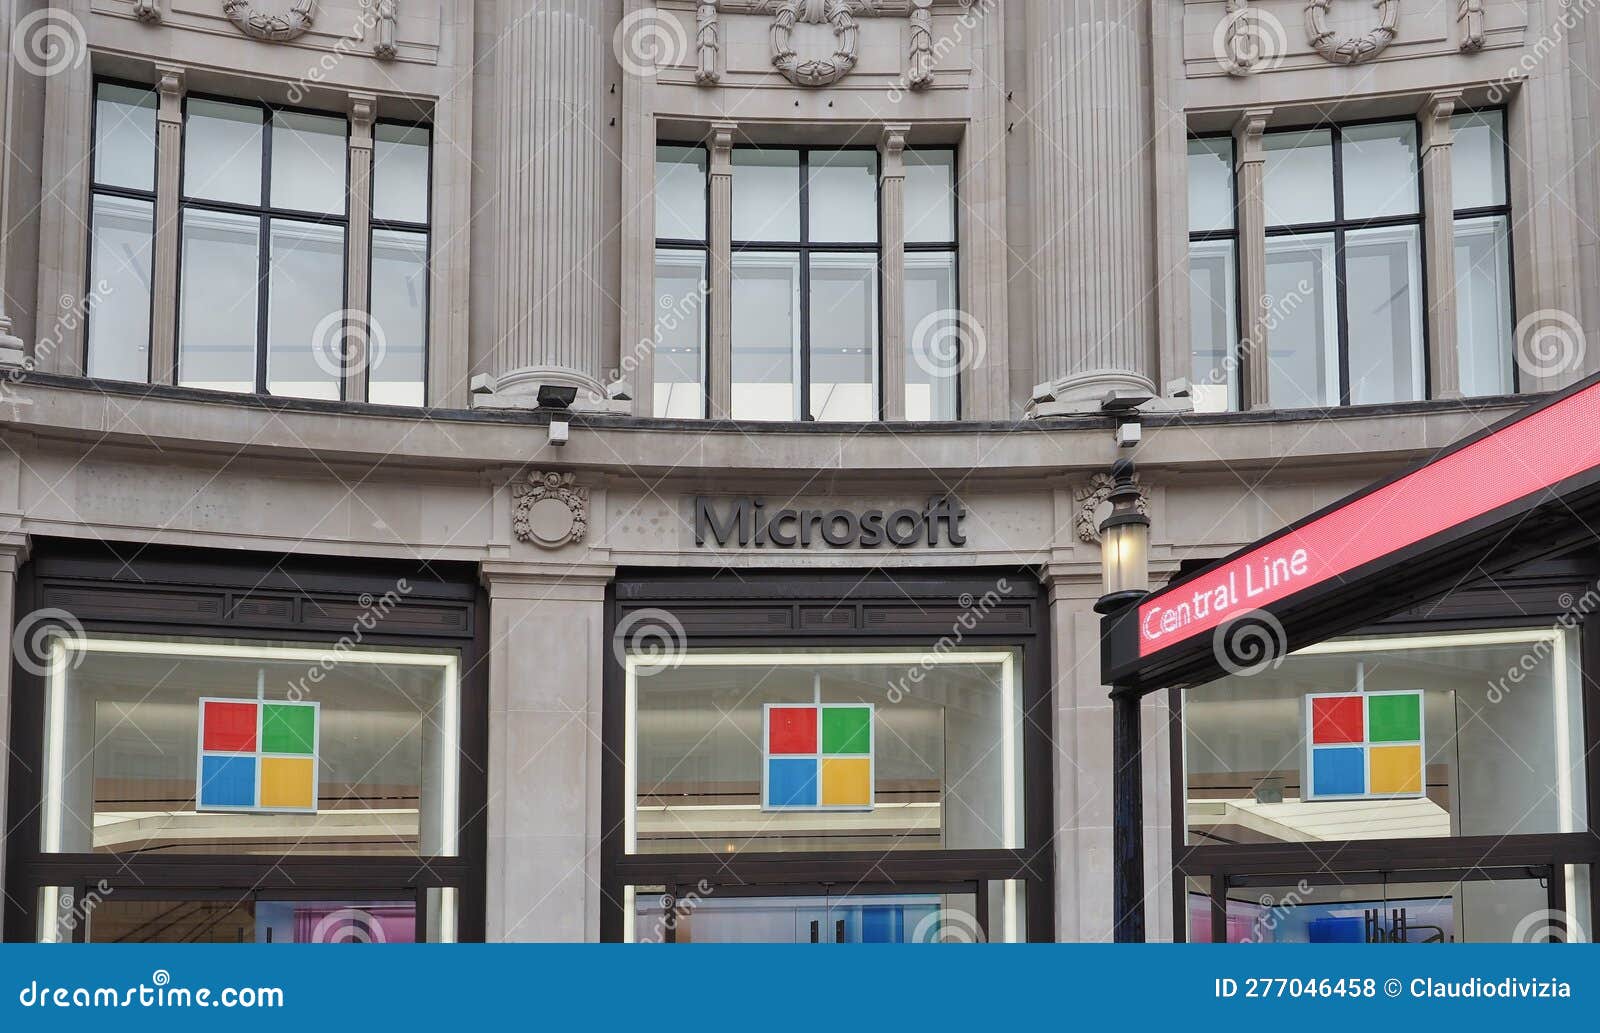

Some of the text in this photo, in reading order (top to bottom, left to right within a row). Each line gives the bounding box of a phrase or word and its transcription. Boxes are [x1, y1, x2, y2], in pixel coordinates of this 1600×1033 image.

[695, 496, 966, 547] Microsoft
[1143, 548, 1308, 640] Central Line
